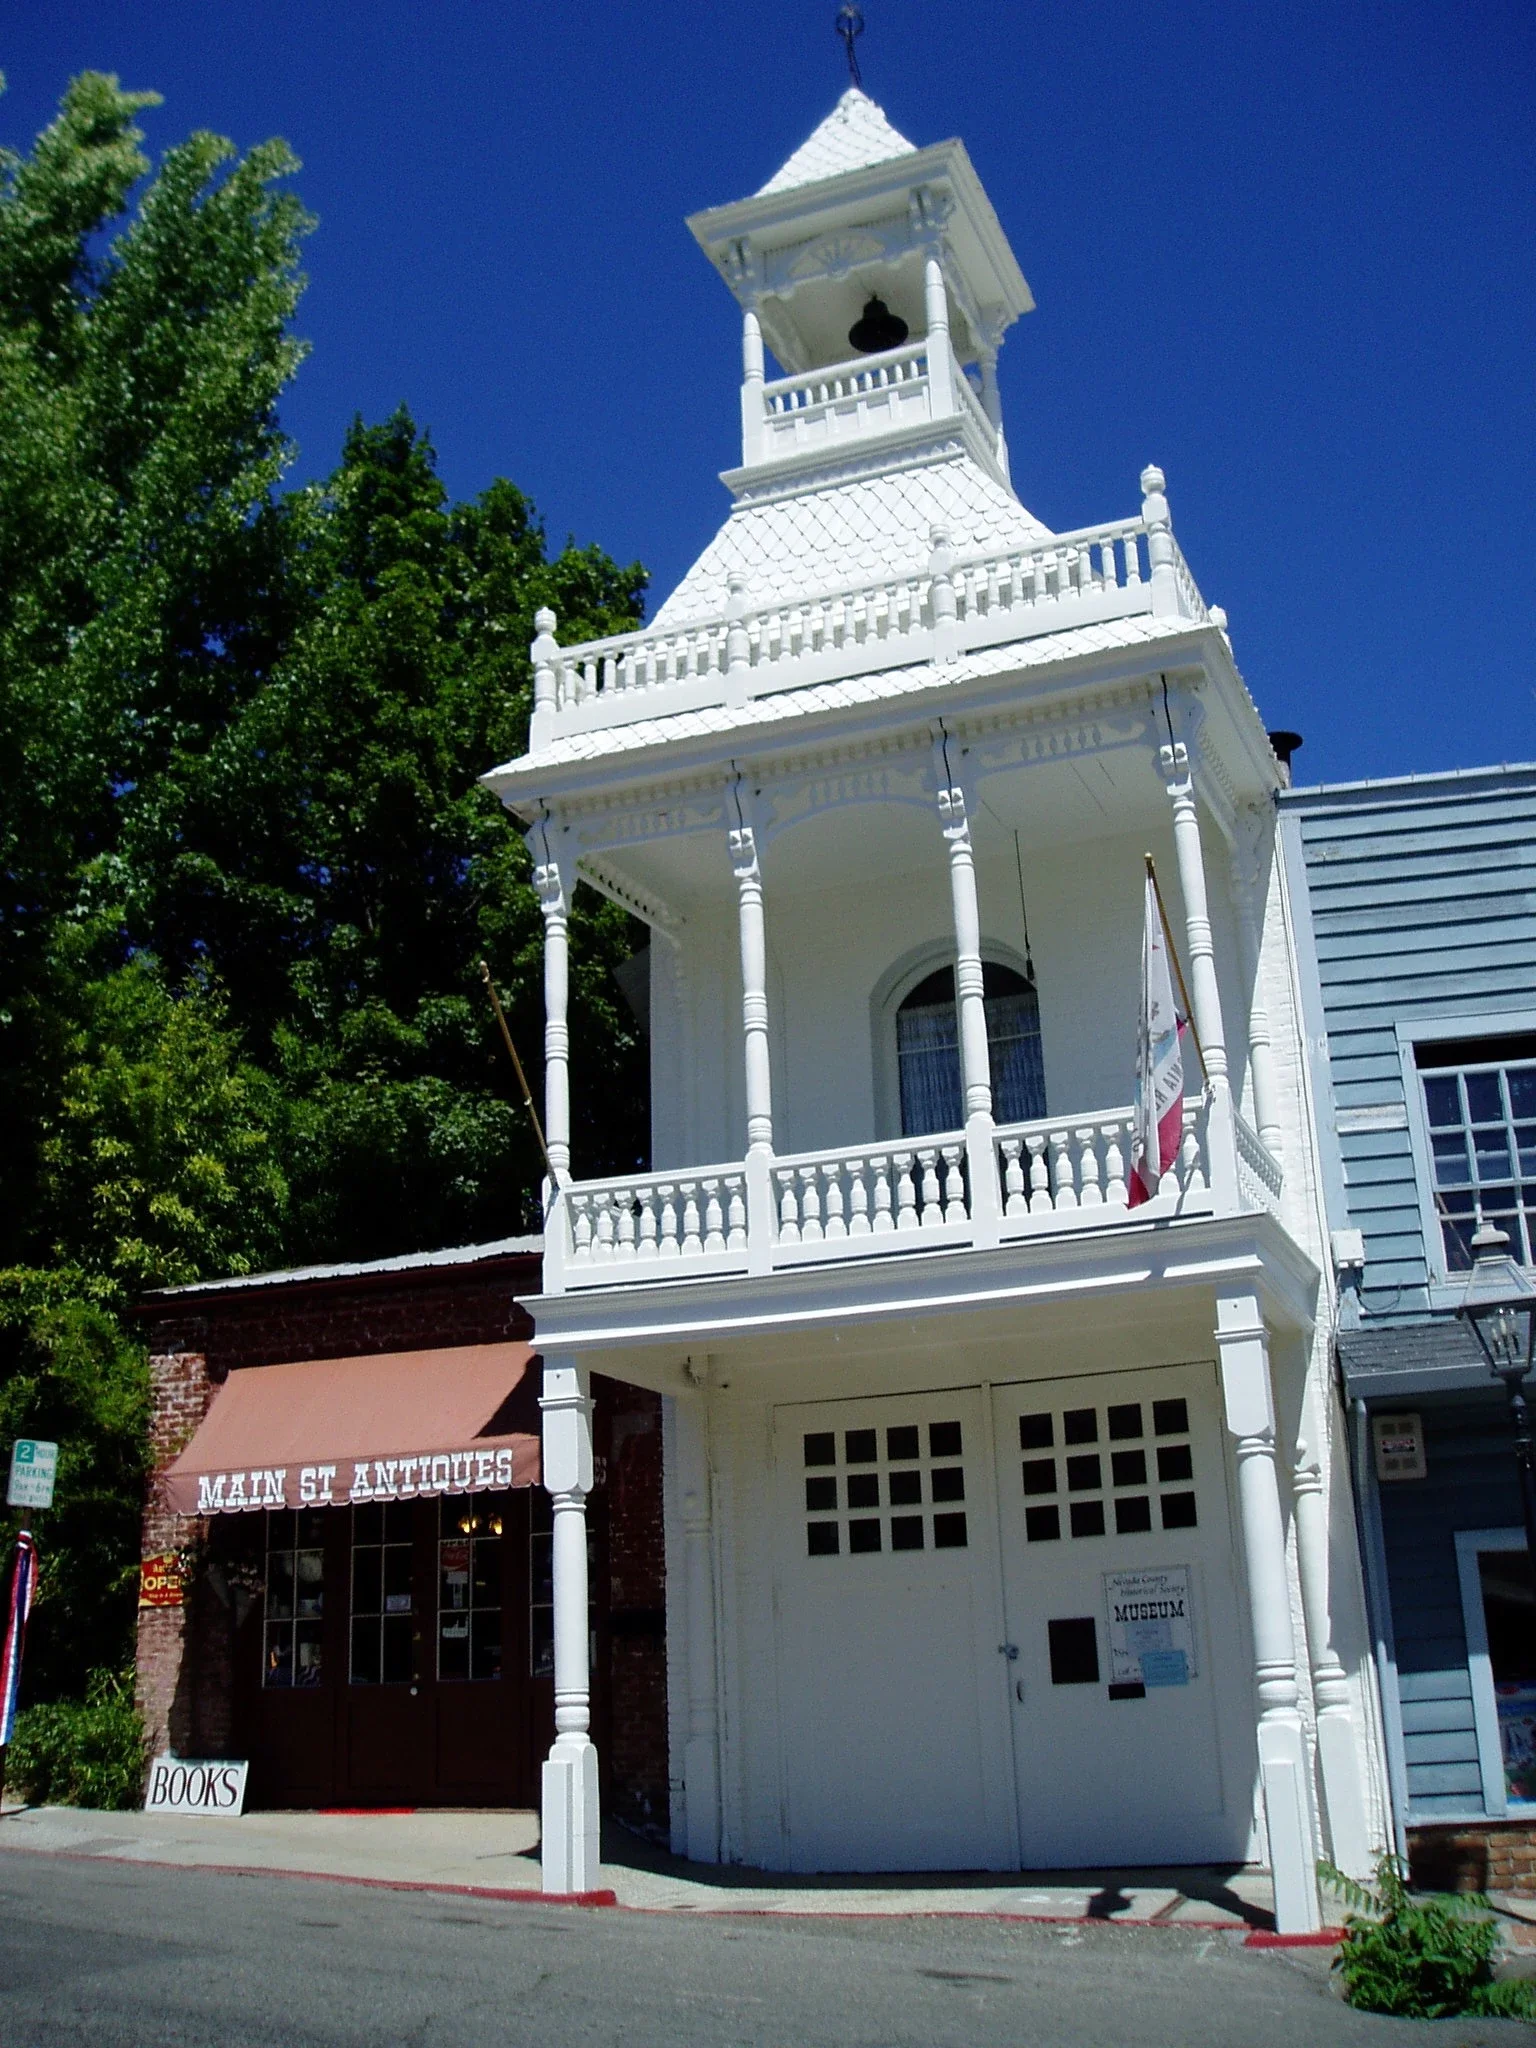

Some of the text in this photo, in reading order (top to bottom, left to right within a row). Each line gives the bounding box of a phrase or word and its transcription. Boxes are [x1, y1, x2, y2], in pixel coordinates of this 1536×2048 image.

[20, 1444, 31, 1459] 2
[15, 1464, 54, 1480] PARKING
[197, 1448, 513, 1509] MAIN ST ANTIQUES
[144, 1575, 182, 1590] OPE
[1114, 1599, 1184, 1622] MUSEUM
[151, 1766, 239, 1807] BOOKS
